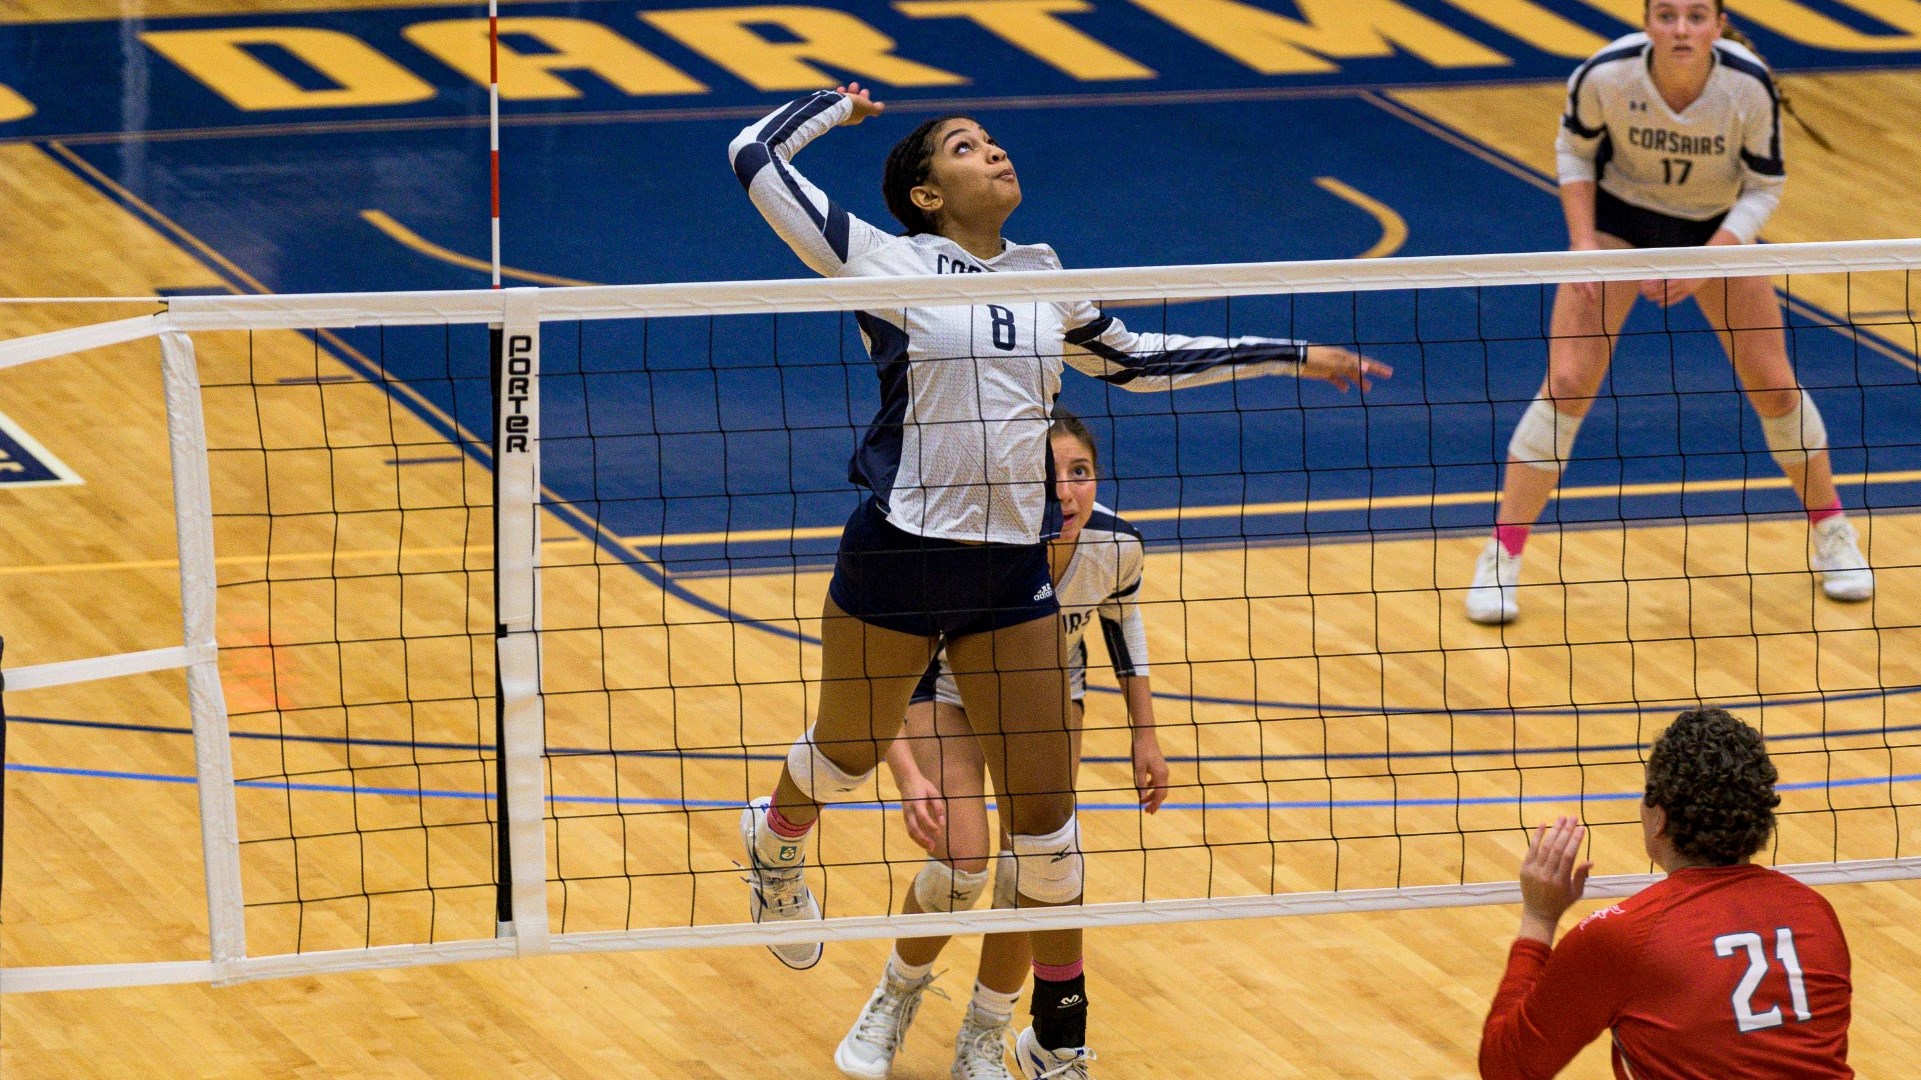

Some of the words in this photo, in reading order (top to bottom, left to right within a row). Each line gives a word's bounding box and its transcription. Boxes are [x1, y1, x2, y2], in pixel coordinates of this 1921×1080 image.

[1628, 127, 1725, 154] CORSAIRS
[1661, 157, 1692, 185] 17
[987, 304, 1016, 351] 8
[1713, 926, 1812, 1034] 21
